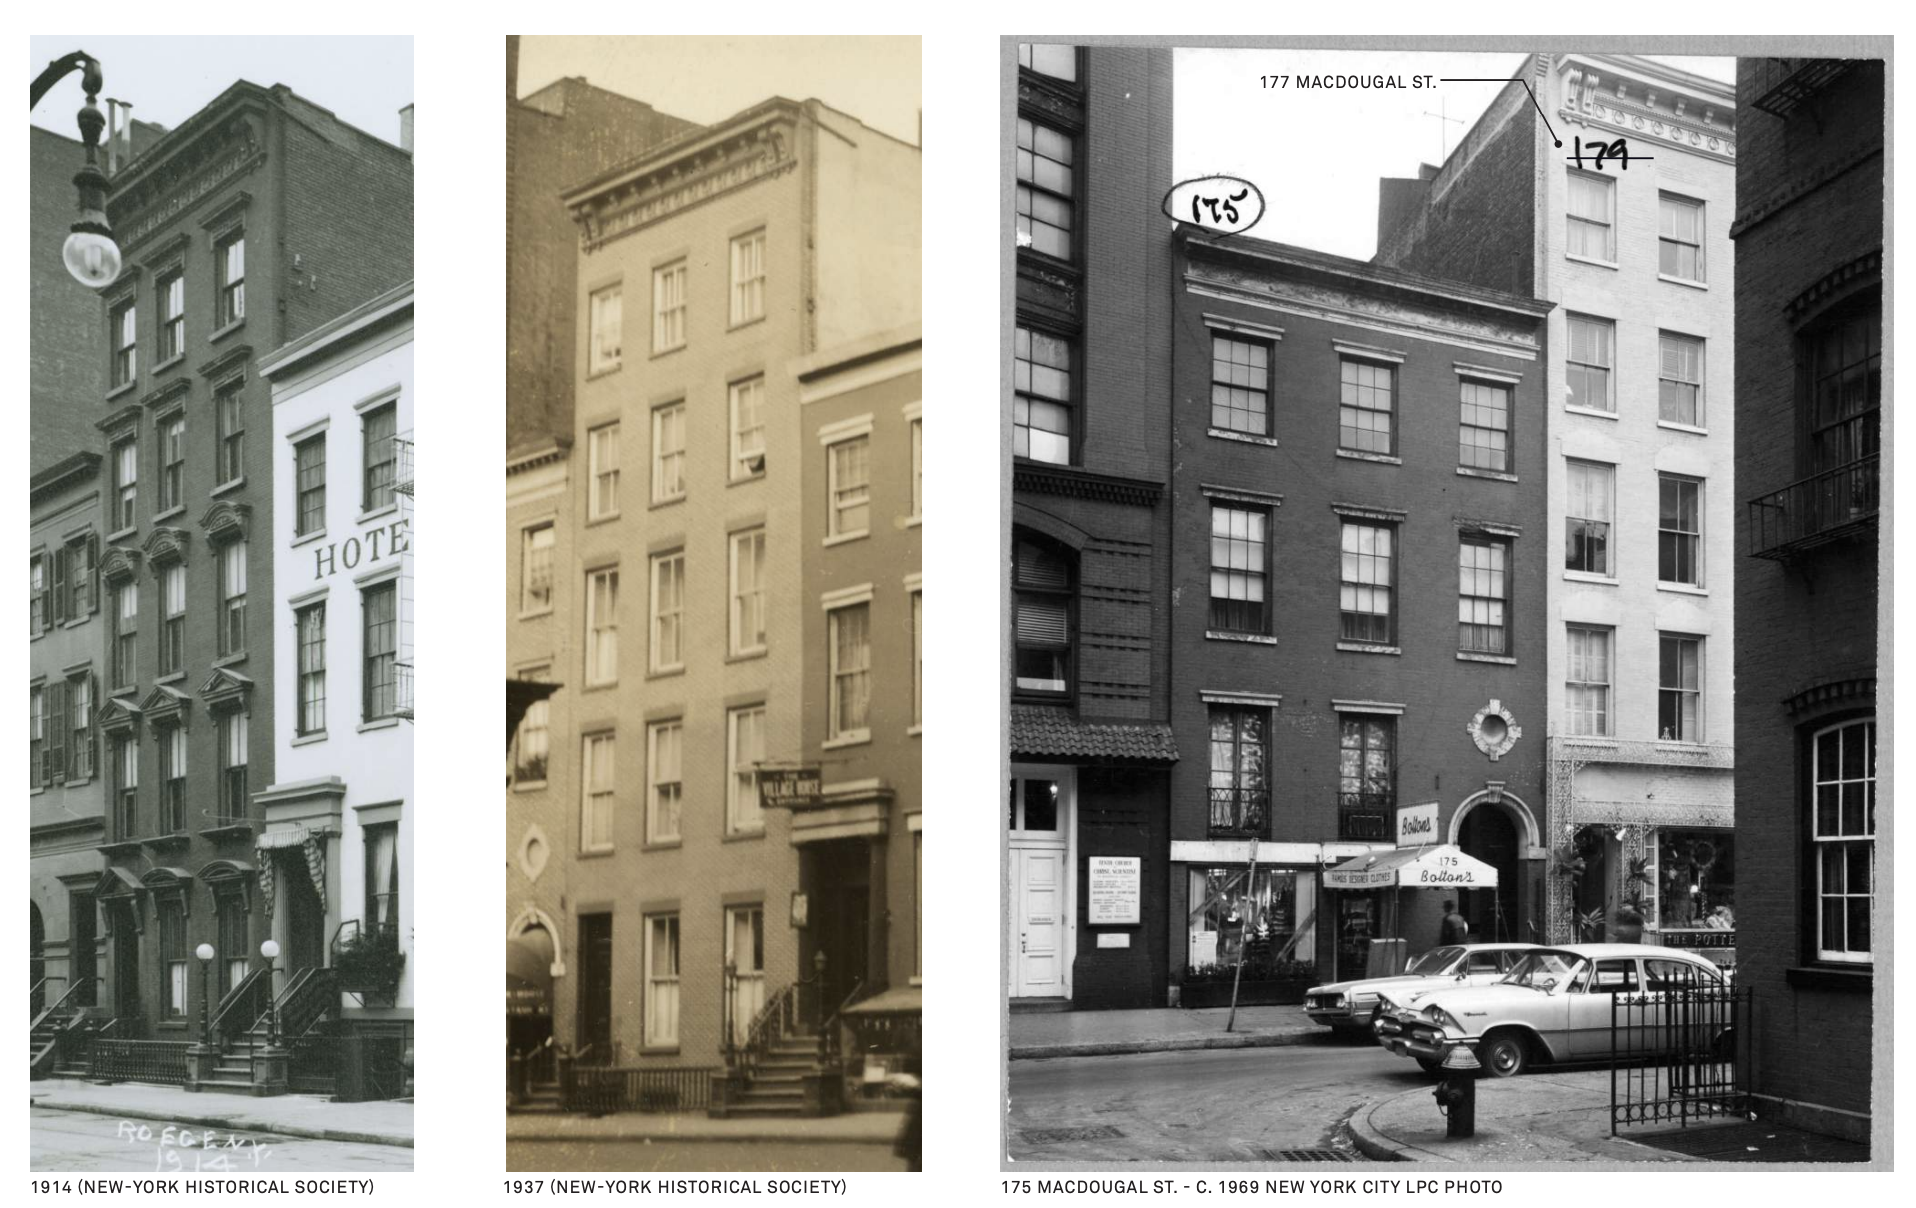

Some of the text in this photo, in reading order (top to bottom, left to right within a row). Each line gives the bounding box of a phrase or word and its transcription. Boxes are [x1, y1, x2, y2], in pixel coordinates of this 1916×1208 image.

[1575, 135, 1629, 171] 179
[1192, 188, 1248, 224] 175
[315, 518, 409, 580] HOTE
[763, 780, 795, 797] VILLAGE
[1439, 856, 1458, 866] 175
[1348, 873, 1369, 884] DESIGNER
[1370, 871, 1391, 882] CLOTHES
[1420, 869, 1475, 883] Bolton's
[155, 1147, 238, 1172] 1914
